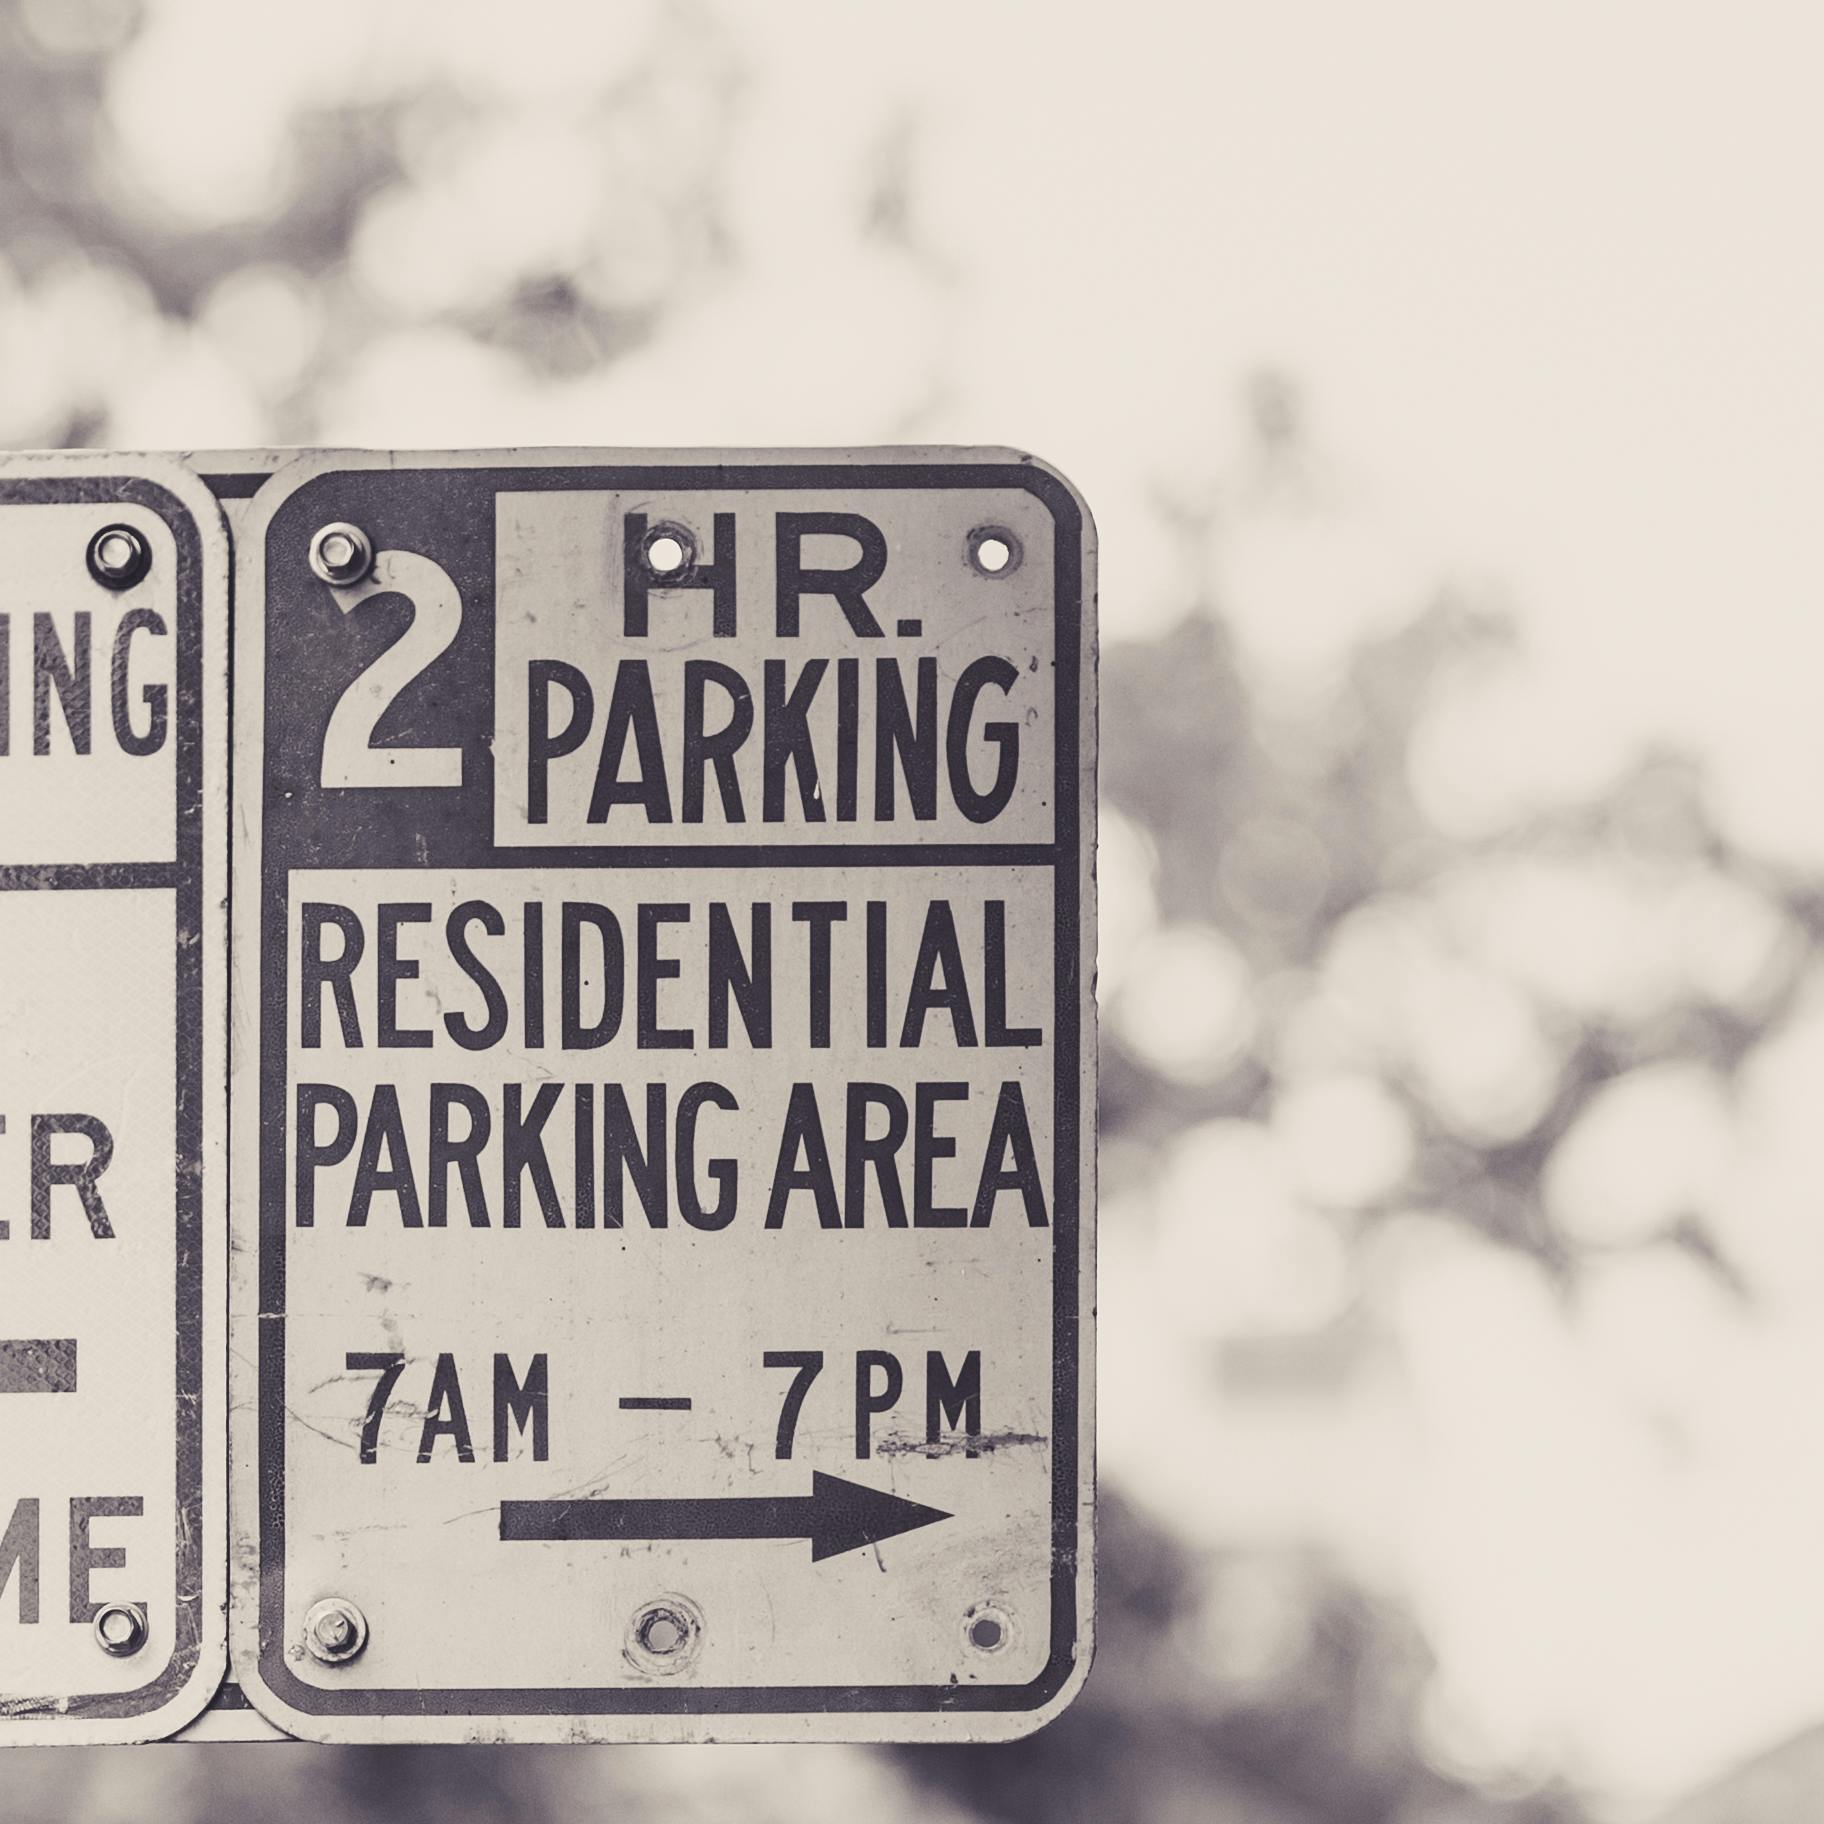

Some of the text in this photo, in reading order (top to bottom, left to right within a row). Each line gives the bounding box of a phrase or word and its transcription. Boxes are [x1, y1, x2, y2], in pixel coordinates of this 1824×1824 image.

[319, 511, 922, 789] 2 HR.
[526, 656, 1021, 825] PARKING
[300, 900, 1044, 1051] RESIDENTIAL
[294, 1080, 1049, 1231] PARKING AREA
[345, 1352, 550, 1464] 7AM
[762, 1350, 982, 1460] 7PM
